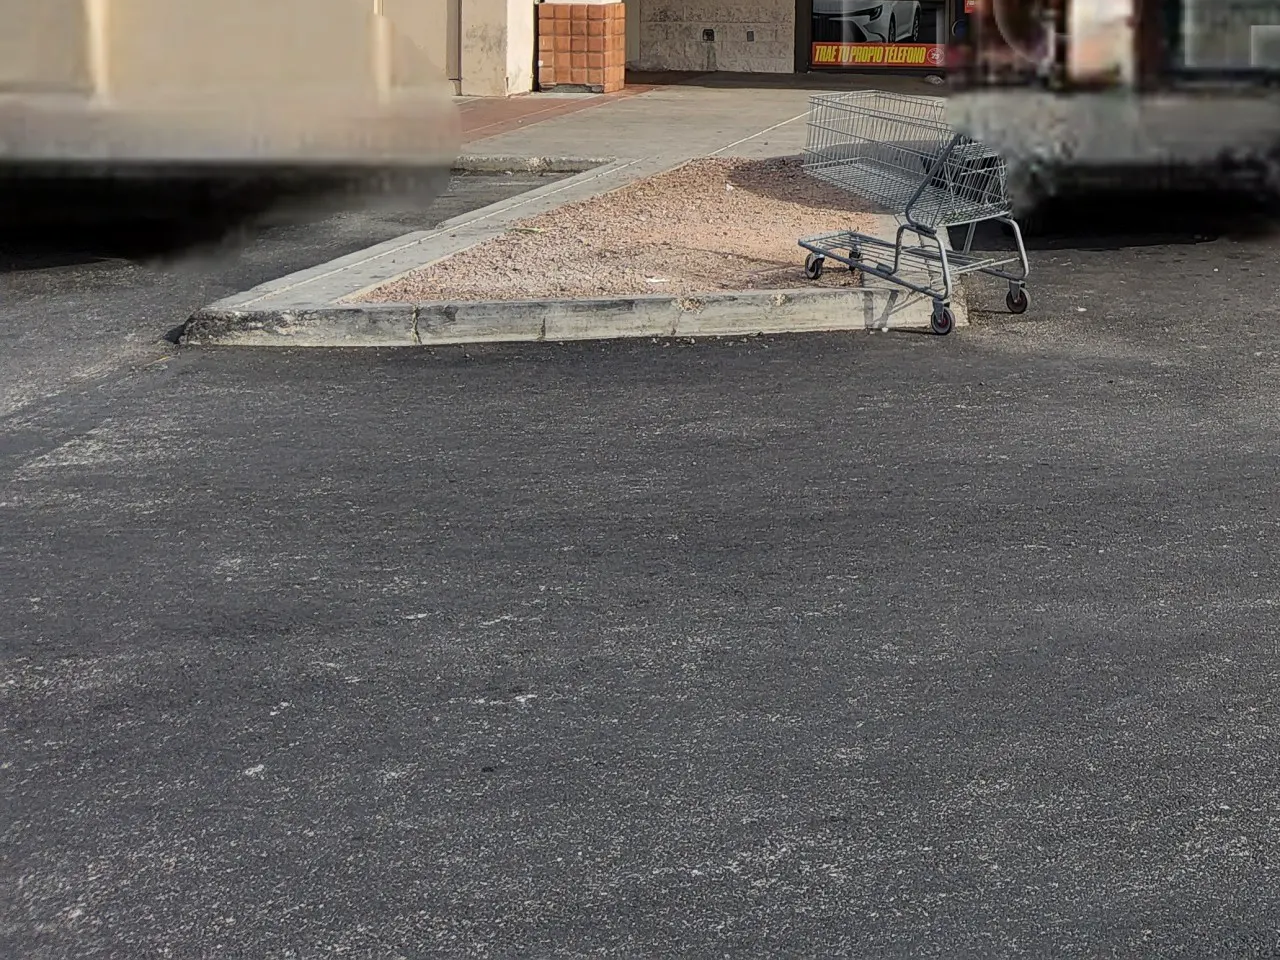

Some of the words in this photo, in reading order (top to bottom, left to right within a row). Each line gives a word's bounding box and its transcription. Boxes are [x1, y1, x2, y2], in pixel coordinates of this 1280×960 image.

[814, 45, 837, 62] TRAE
[838, 45, 850, 62] TU
[849, 46, 884, 62] PROPIO
